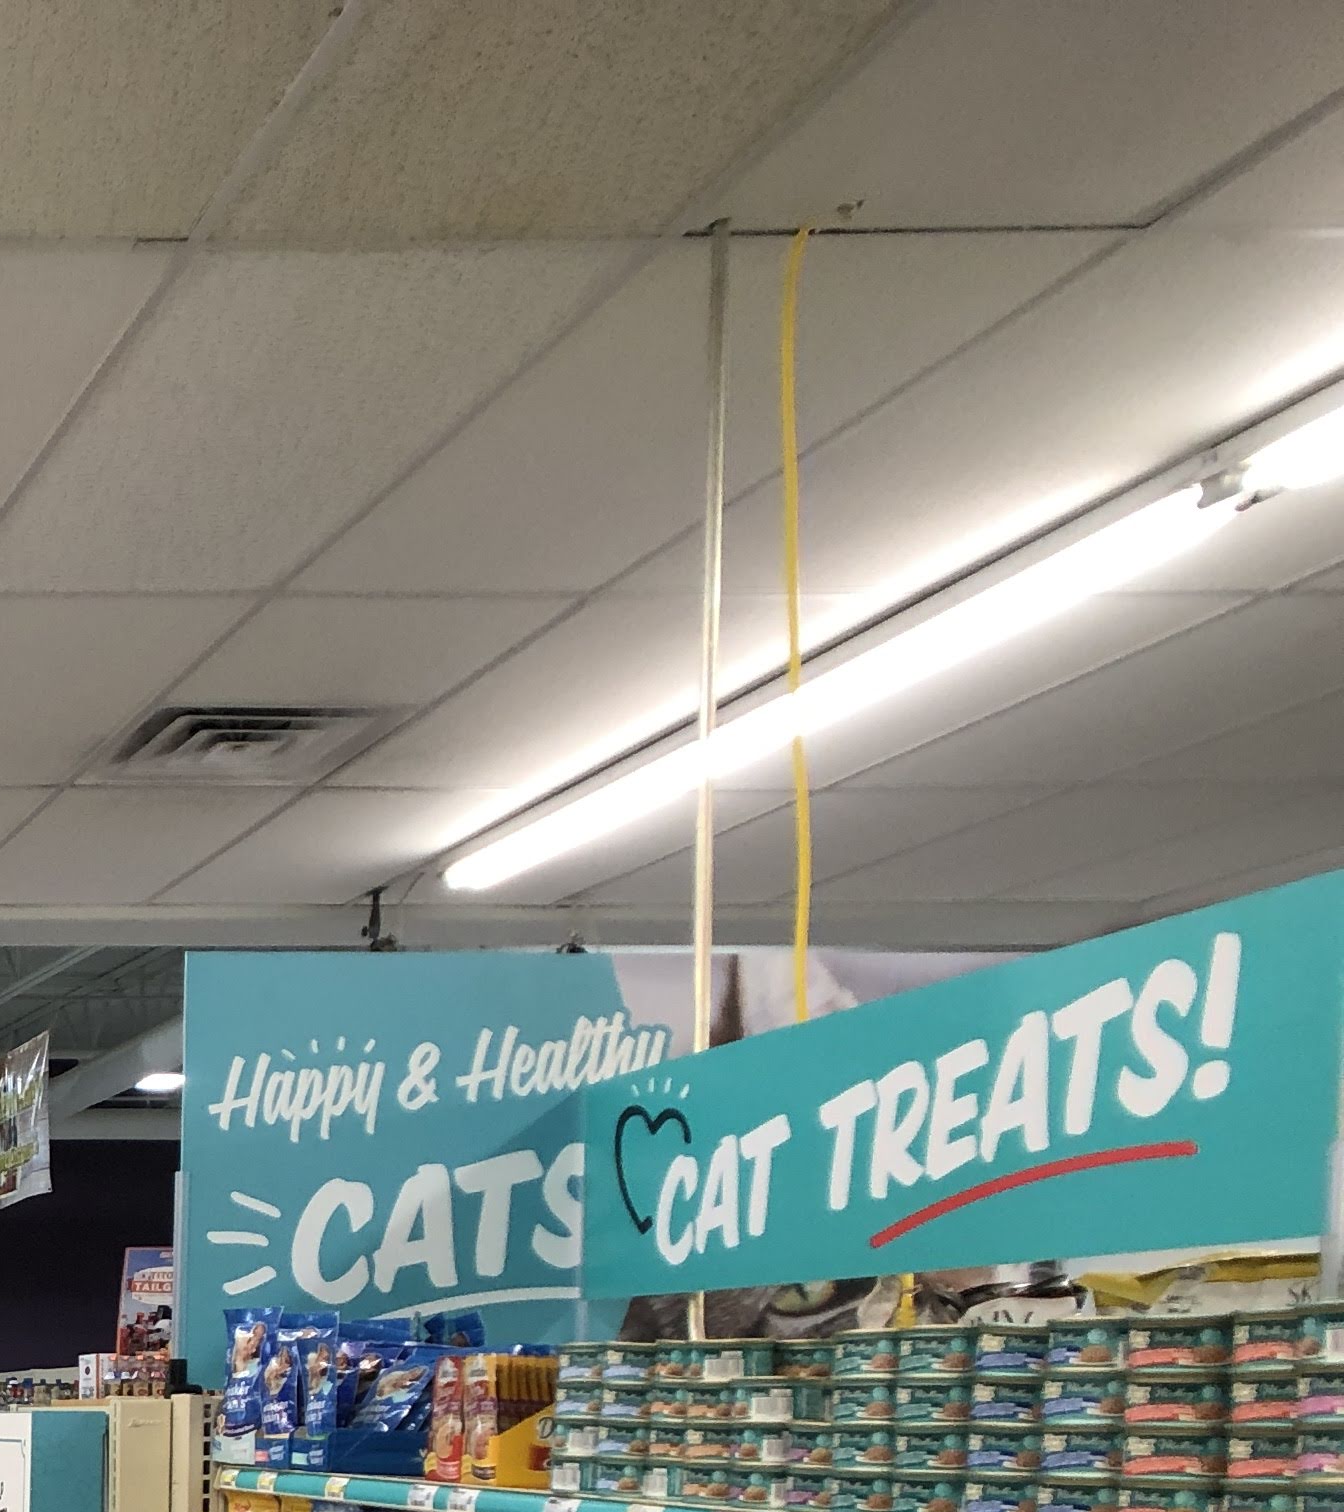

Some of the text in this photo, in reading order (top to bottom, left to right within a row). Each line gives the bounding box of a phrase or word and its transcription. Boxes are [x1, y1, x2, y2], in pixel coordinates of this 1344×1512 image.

[209, 1010, 667, 1143] Happy & Healthy
[654, 931, 1242, 1265] CAT TREATS!
[291, 1142, 585, 1304] CATS
